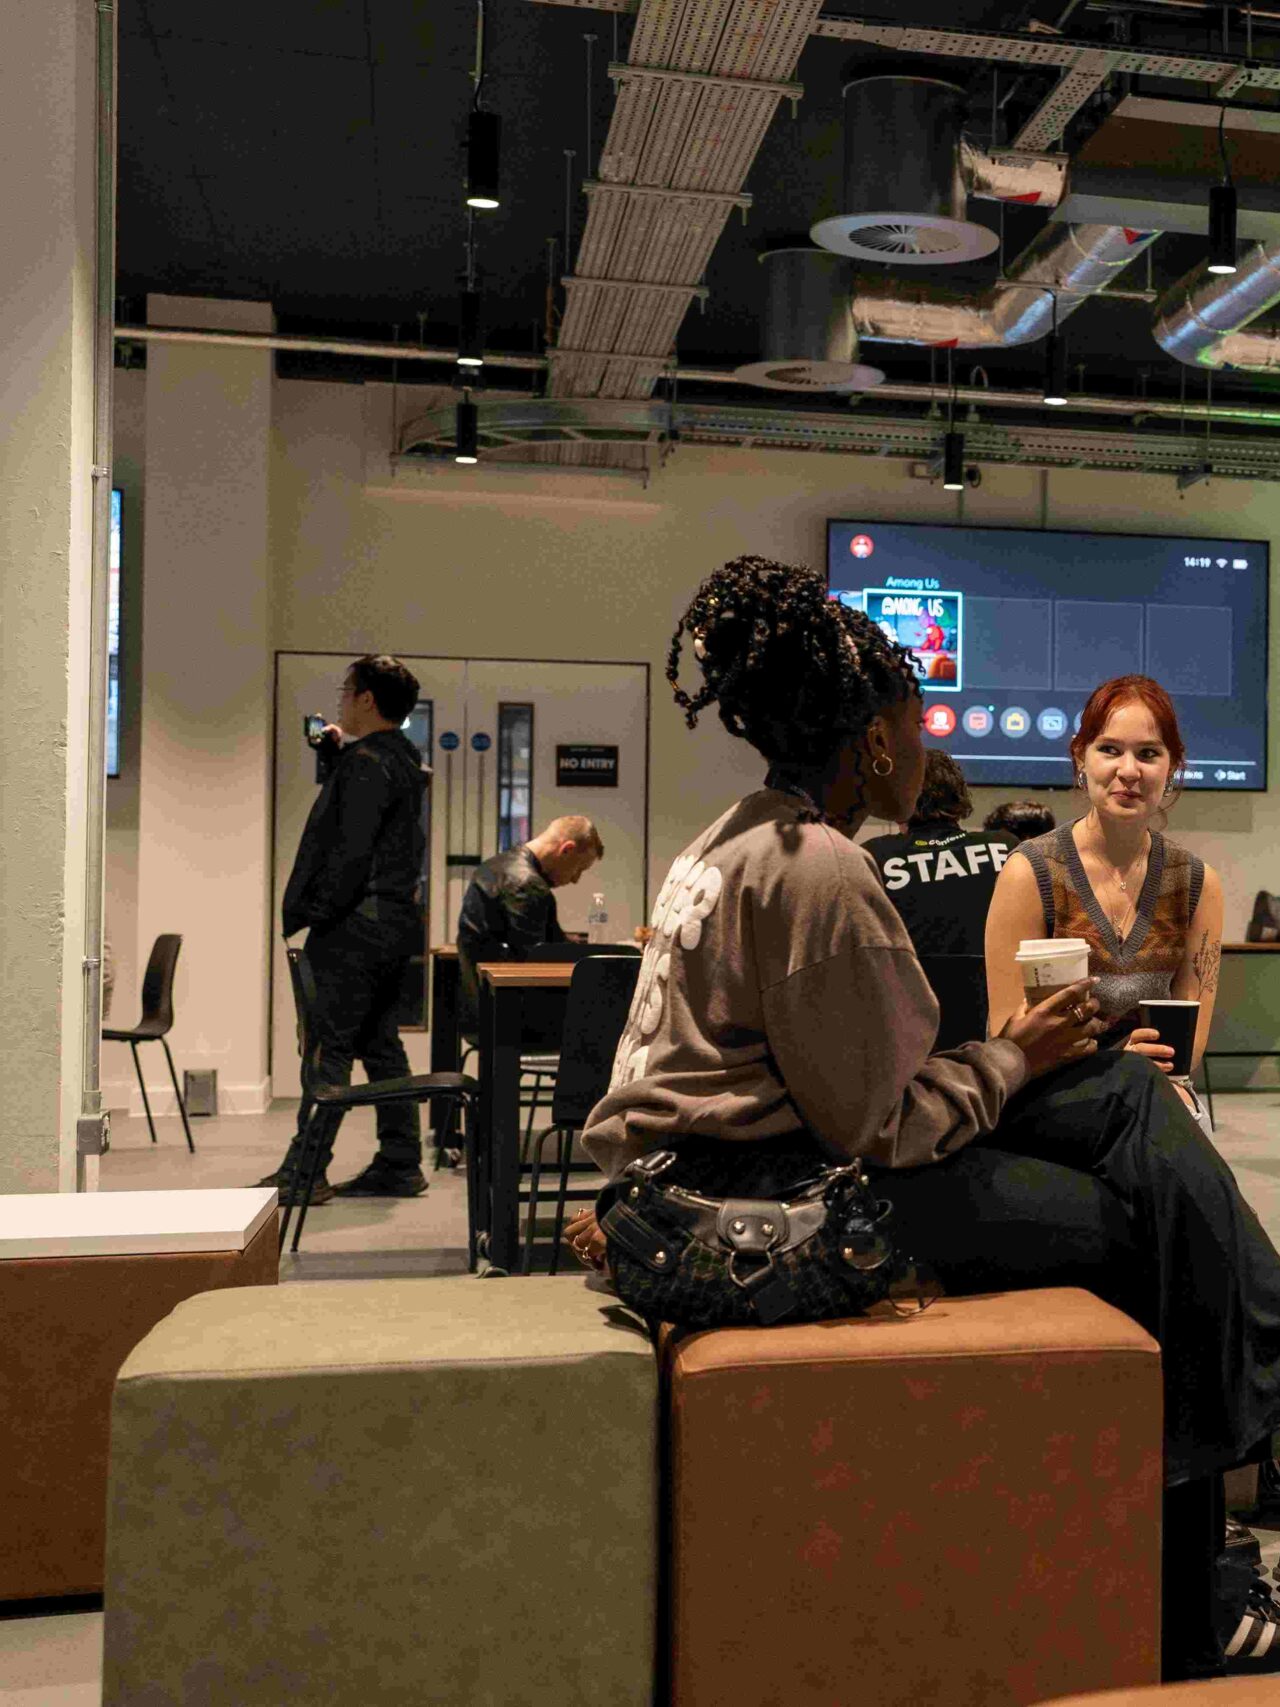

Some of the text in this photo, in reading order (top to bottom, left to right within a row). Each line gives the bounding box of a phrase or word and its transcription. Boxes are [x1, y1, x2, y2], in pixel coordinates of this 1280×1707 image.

[885, 576, 940, 591] Among Us
[927, 598, 944, 618] US
[560, 757, 616, 770] NO ENTRY
[883, 842, 1009, 891] STAFF
